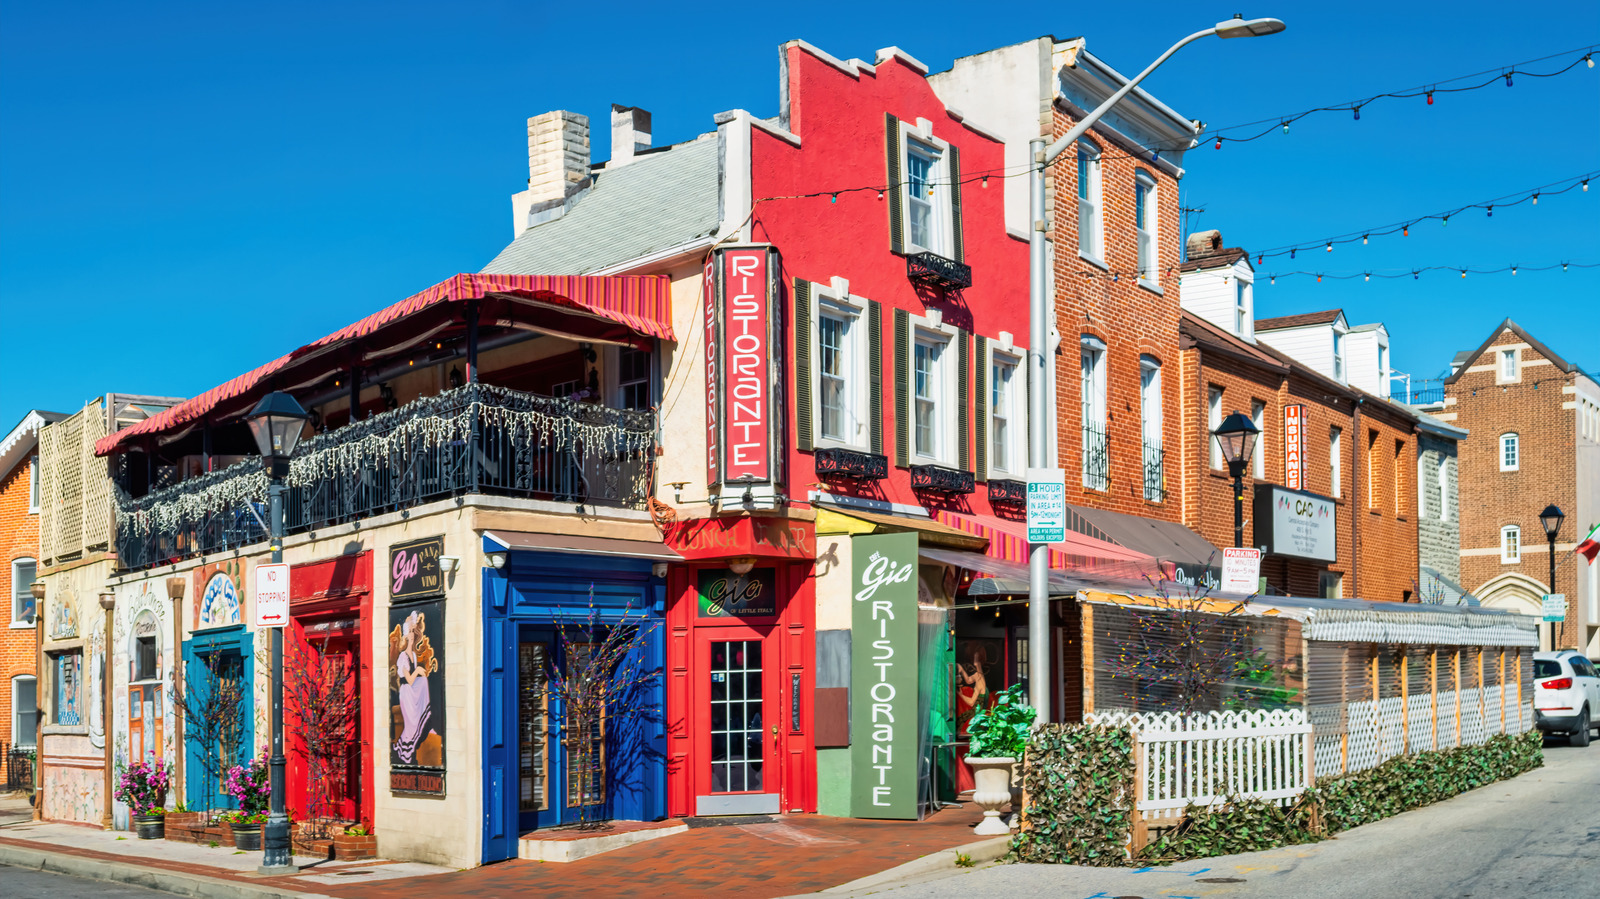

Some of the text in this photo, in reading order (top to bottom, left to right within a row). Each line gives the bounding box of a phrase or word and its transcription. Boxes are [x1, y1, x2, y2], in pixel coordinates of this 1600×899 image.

[1287, 408, 1298, 487] INSURANCE
[1030, 484, 1036, 492] 3
[1295, 500, 1313, 518] CAC
[676, 525, 740, 551] LUNCH
[1226, 550, 1258, 558] PARKING
[1235, 559, 1257, 567] MINUTES
[267, 571, 276, 581] NO
[421, 575, 437, 587] VINO
[258, 591, 286, 603] STOPPING
